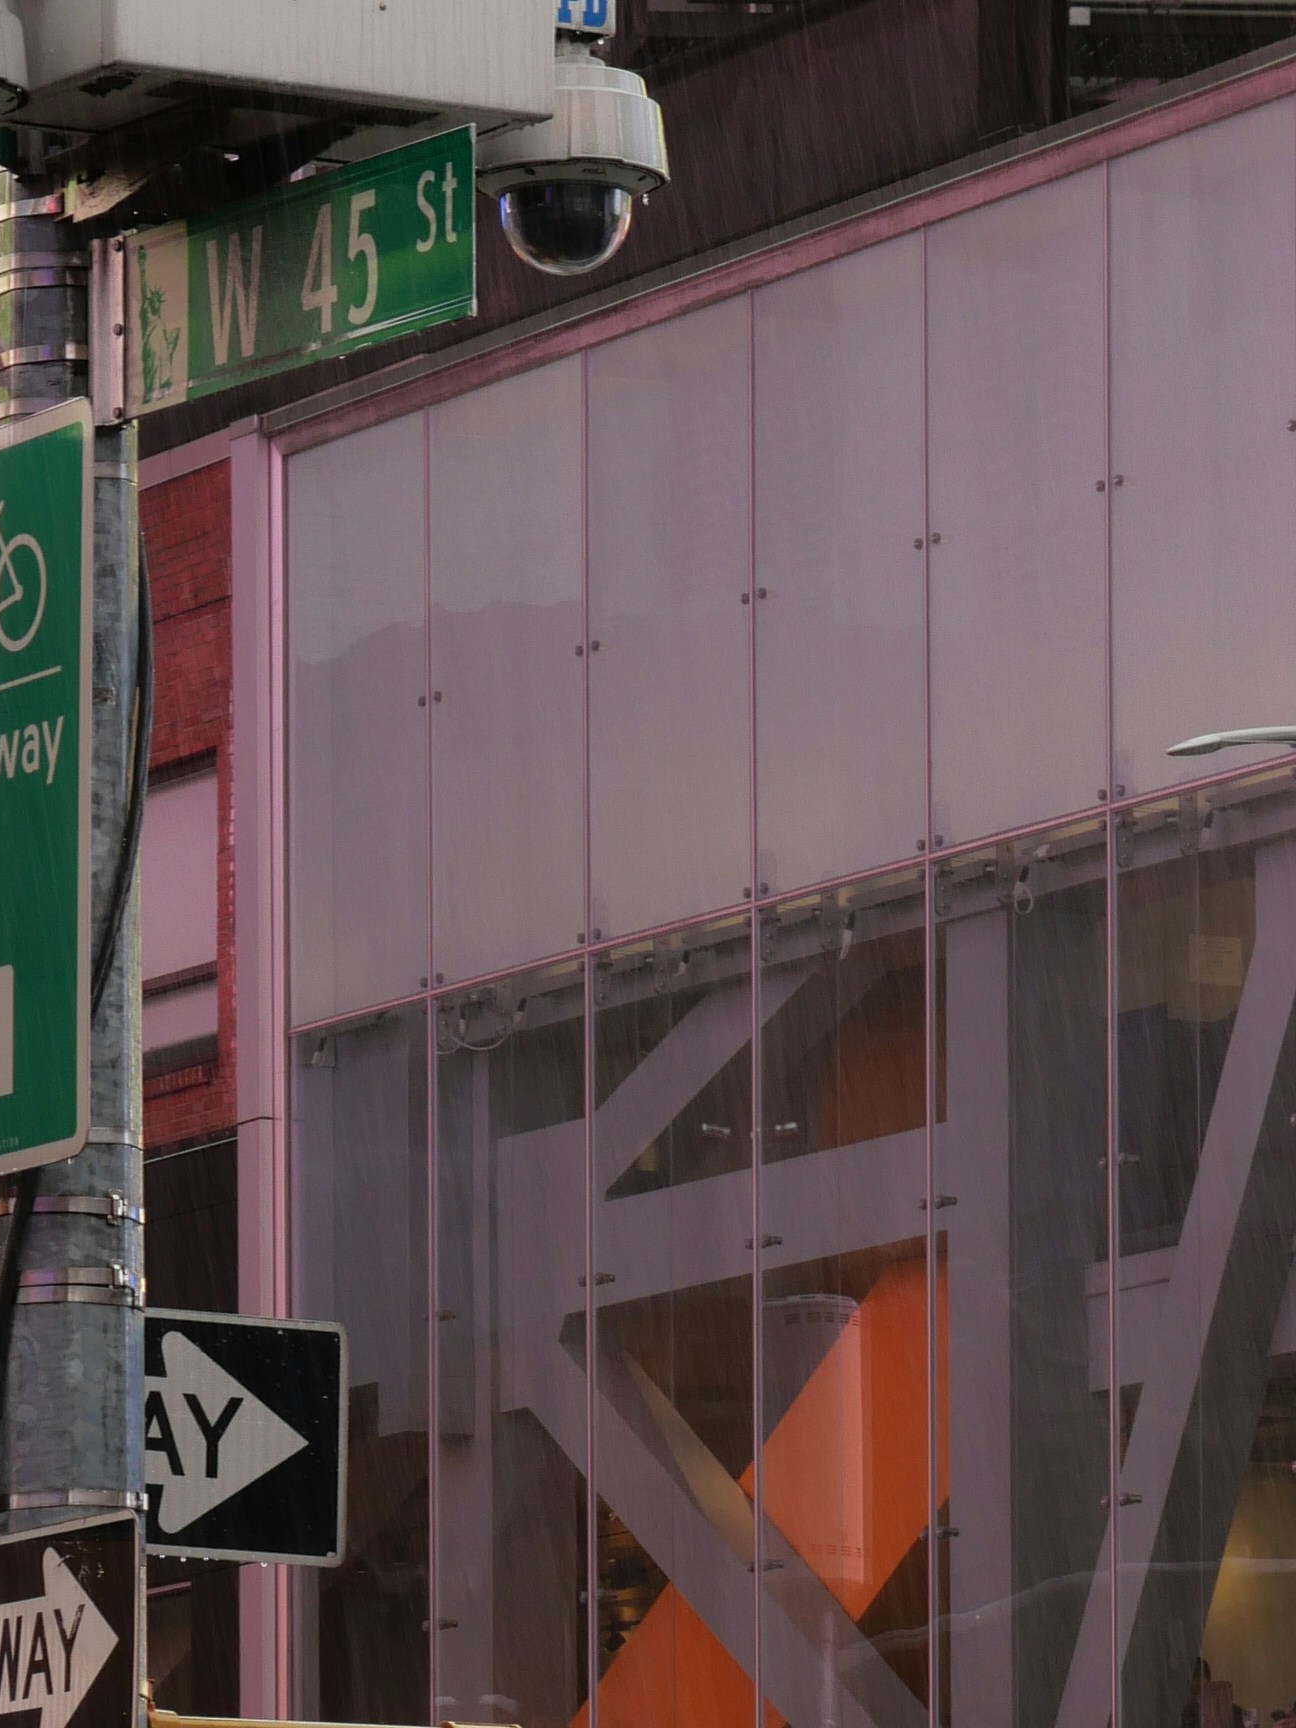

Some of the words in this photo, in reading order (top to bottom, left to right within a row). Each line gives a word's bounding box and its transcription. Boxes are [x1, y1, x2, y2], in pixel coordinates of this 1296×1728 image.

[205, 225, 263, 366] W
[301, 188, 378, 334] 45
[415, 161, 458, 253] St
[146, 1391, 245, 1480] AY
